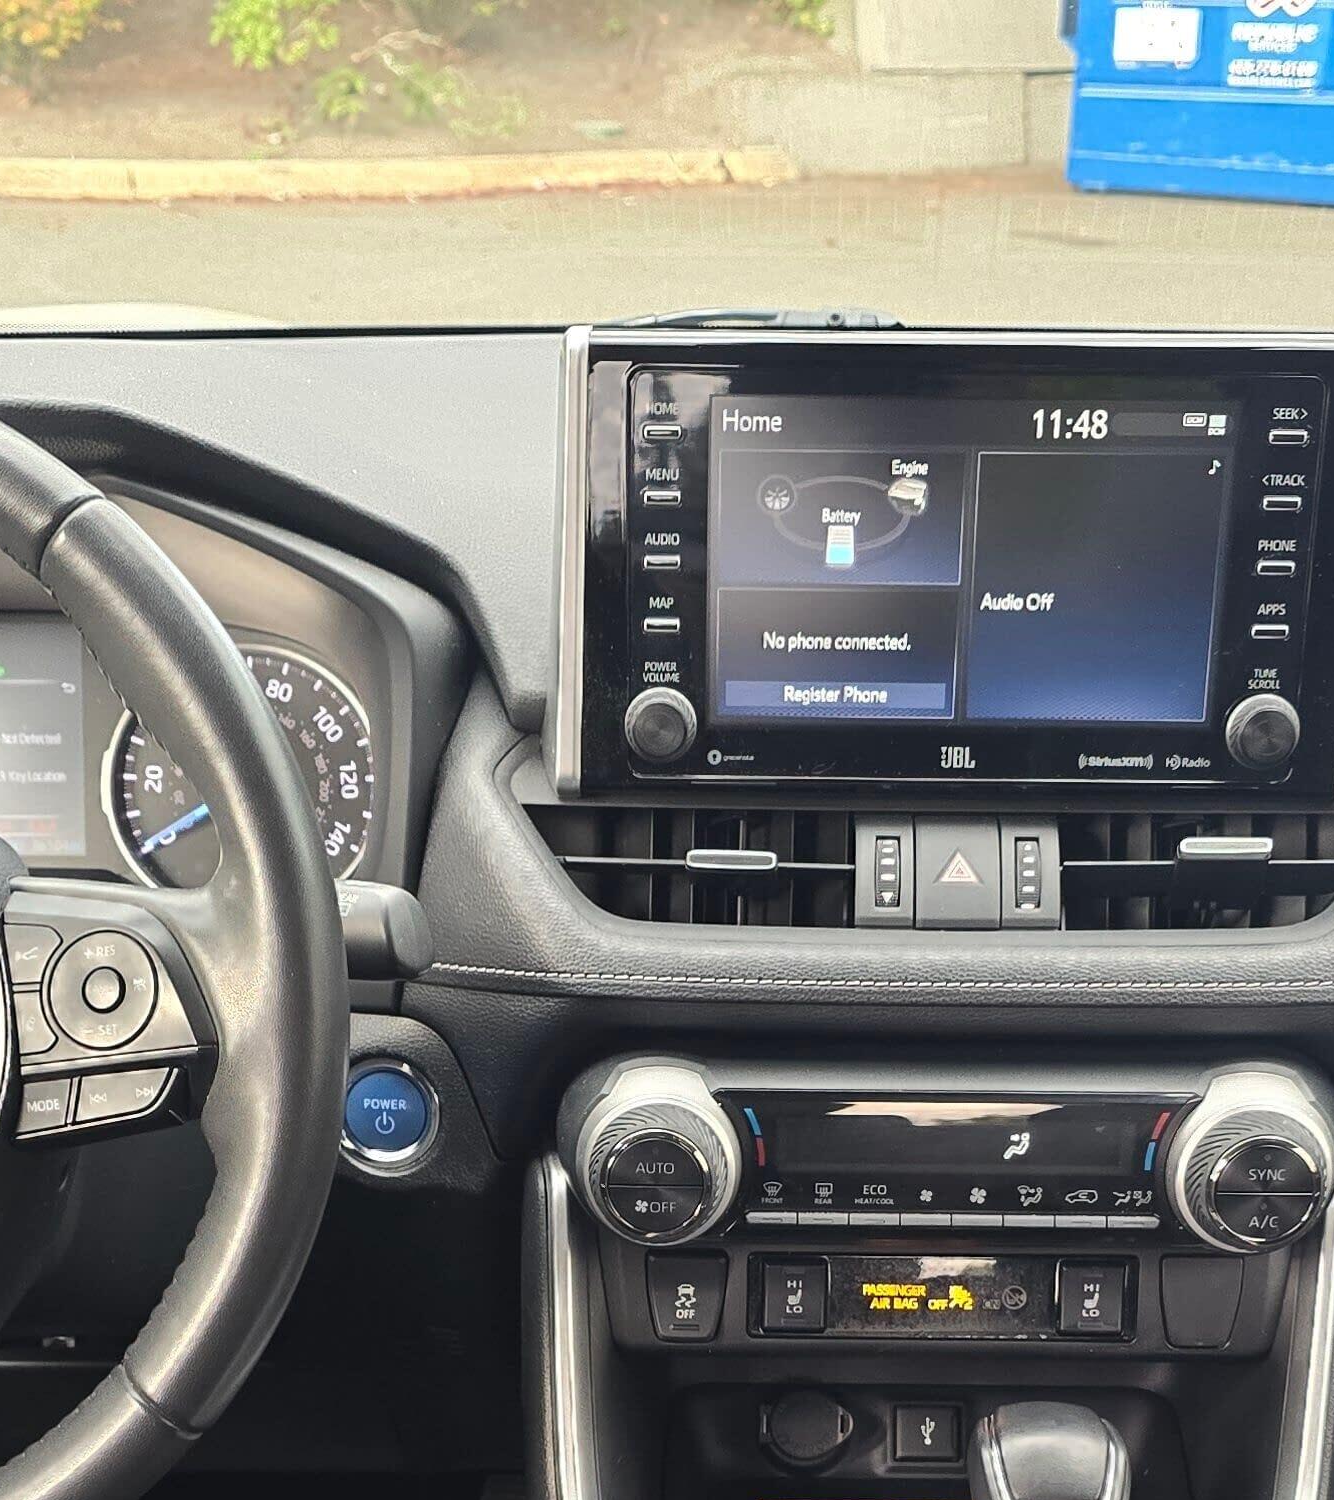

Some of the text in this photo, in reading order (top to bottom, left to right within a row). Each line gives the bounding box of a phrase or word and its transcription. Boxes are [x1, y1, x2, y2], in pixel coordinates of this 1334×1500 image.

[646, 402, 679, 415] HOME
[722, 408, 783, 433] Home
[1032, 408, 1109, 440] 11:48
[645, 468, 680, 481] MENU
[891, 459, 929, 478] Engine
[821, 507, 862, 526] Battery
[644, 533, 680, 546] AUDIO
[1257, 539, 1297, 552] PHONE
[649, 597, 675, 609] MAP
[980, 593, 1055, 612] Audio Off
[1256, 603, 1287, 616] APPS
[762, 631, 912, 652] No phone connected.
[645, 661, 677, 672] POWER
[643, 672, 680, 683] VOLUME
[1253, 668, 1278, 679] TUNE
[265, 678, 293, 703] 80
[1247, 679, 1281, 690] SCROLL
[783, 685, 888, 705] Register Phone
[312, 705, 344, 743] 100
[940, 746, 976, 769] JBL
[1181, 756, 1211, 768] Radio
[143, 764, 164, 794] 20
[338, 759, 359, 799] 120
[324, 820, 352, 857] 140
[26, 1099, 60, 1112] MODE
[363, 1098, 408, 1111] POWER
[634, 1162, 675, 1175] AUTO
[1248, 1168, 1287, 1182] SYNC
[863, 1184, 887, 1196] ECO
[649, 1201, 677, 1214] OFF
[761, 1197, 784, 1205] FRONT
[814, 1197, 832, 1205] REAR
[1248, 1215, 1280, 1229] A/C
[786, 1279, 803, 1289] HI
[862, 1284, 927, 1297] PASSENGER
[1083, 1283, 1100, 1293] HI
[785, 1304, 804, 1315] LO
[870, 1297, 950, 1311] AIR BAG OFF
[675, 1308, 696, 1320] OFF
[1082, 1308, 1101, 1318] LO
